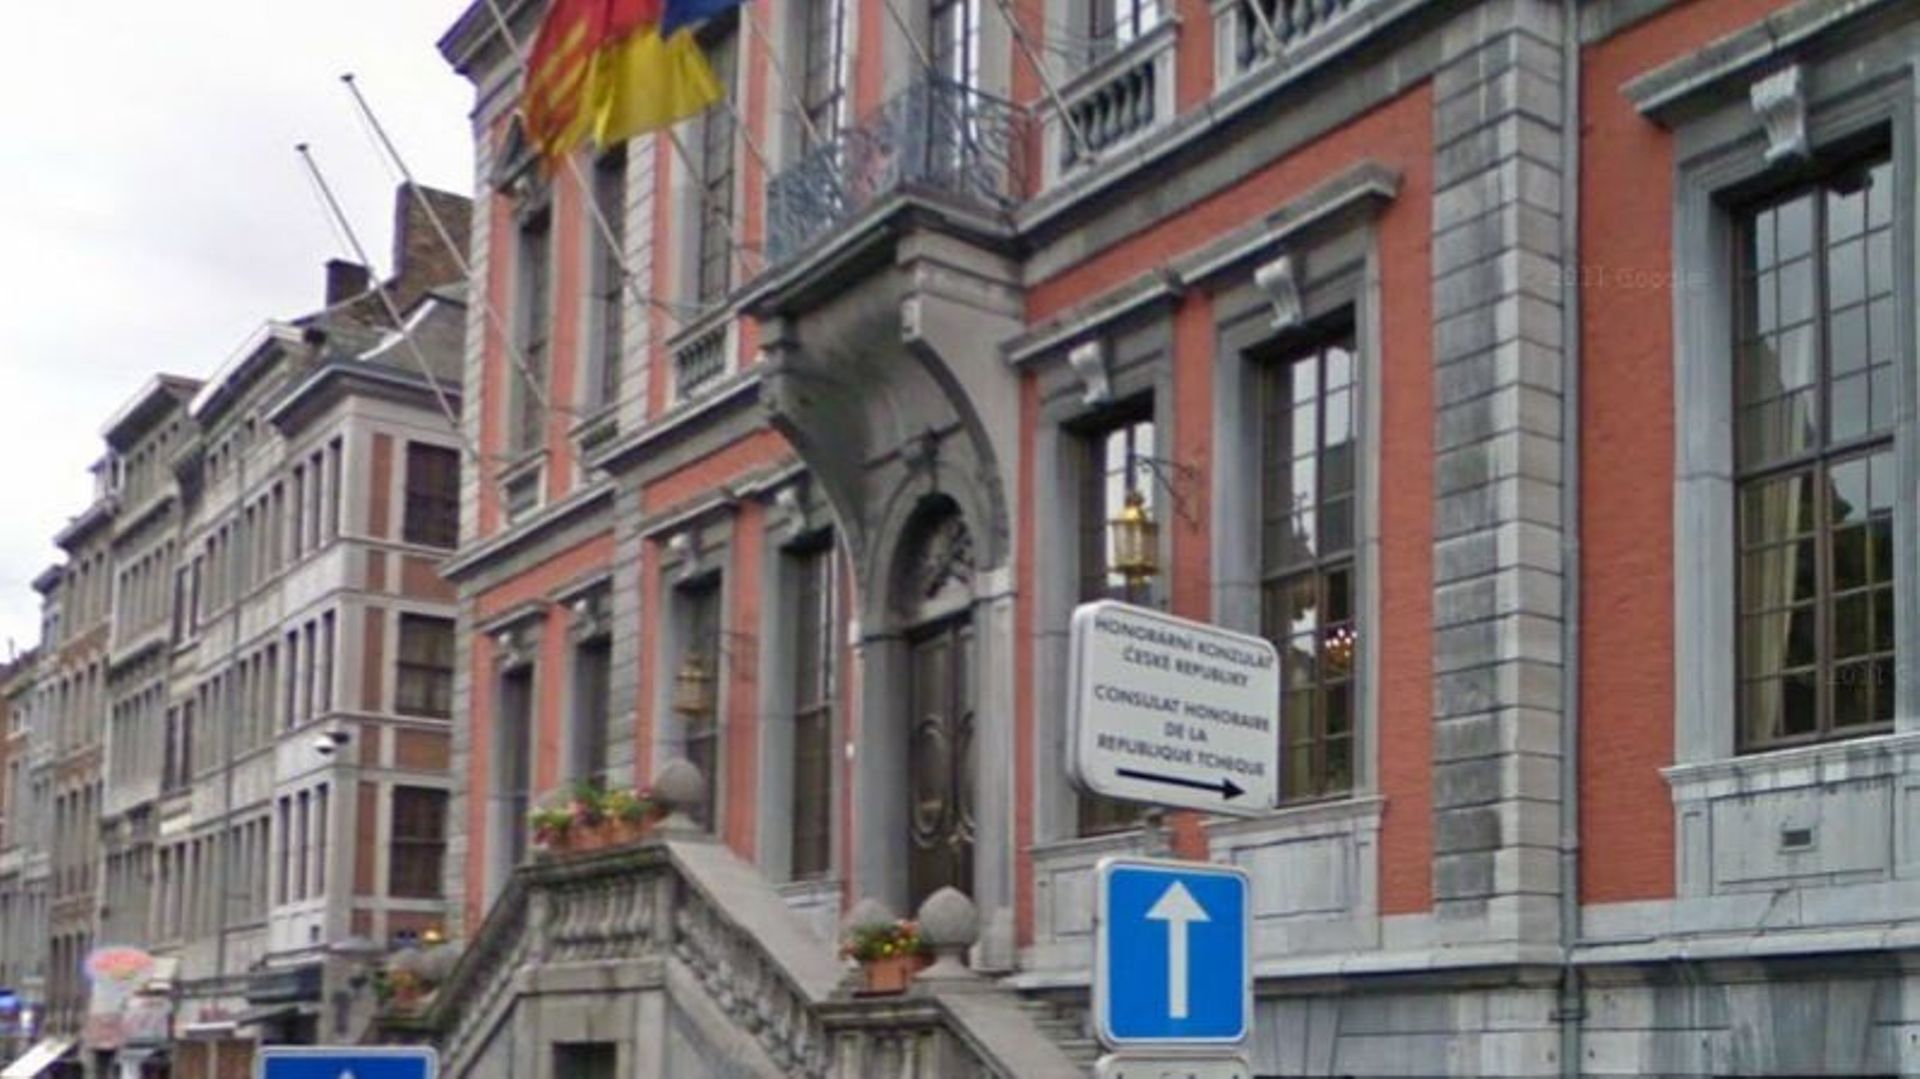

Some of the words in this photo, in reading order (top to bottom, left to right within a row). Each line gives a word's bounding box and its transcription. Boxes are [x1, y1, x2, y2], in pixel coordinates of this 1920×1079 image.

[1094, 685, 1180, 714] CONSULAT
[1184, 702, 1269, 732] HONORAIRE
[1165, 721, 1184, 739] DE
[1189, 728, 1208, 742] LA
